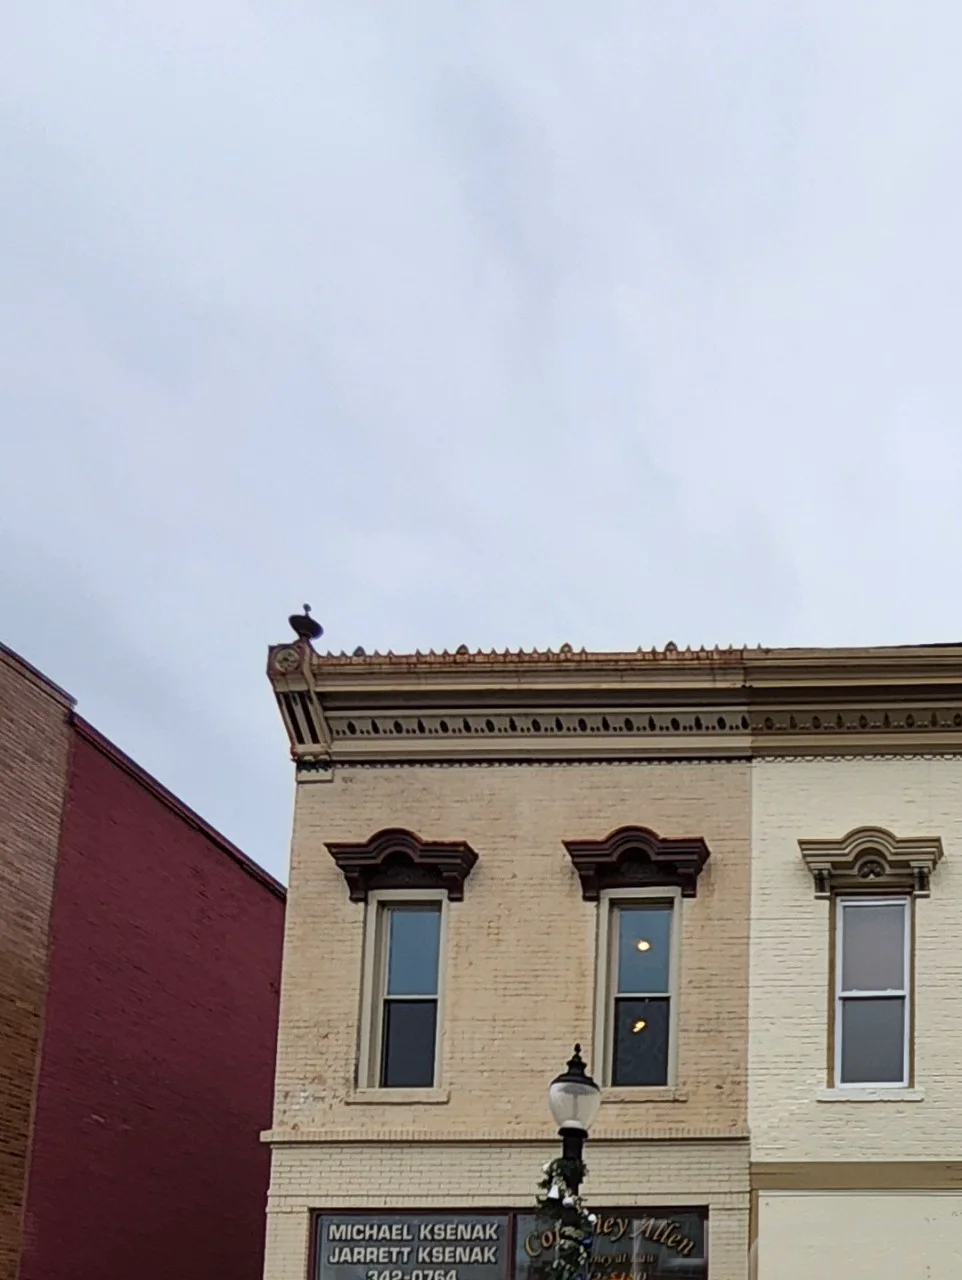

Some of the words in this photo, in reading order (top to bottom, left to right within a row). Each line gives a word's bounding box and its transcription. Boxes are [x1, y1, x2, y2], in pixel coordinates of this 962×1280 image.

[328, 1223, 413, 1241] MICHAEL
[419, 1222, 499, 1241] KSENAK
[631, 1216, 695, 1255] Allen
[328, 1246, 412, 1264] JARRETT
[417, 1245, 497, 1264] KSENAK
